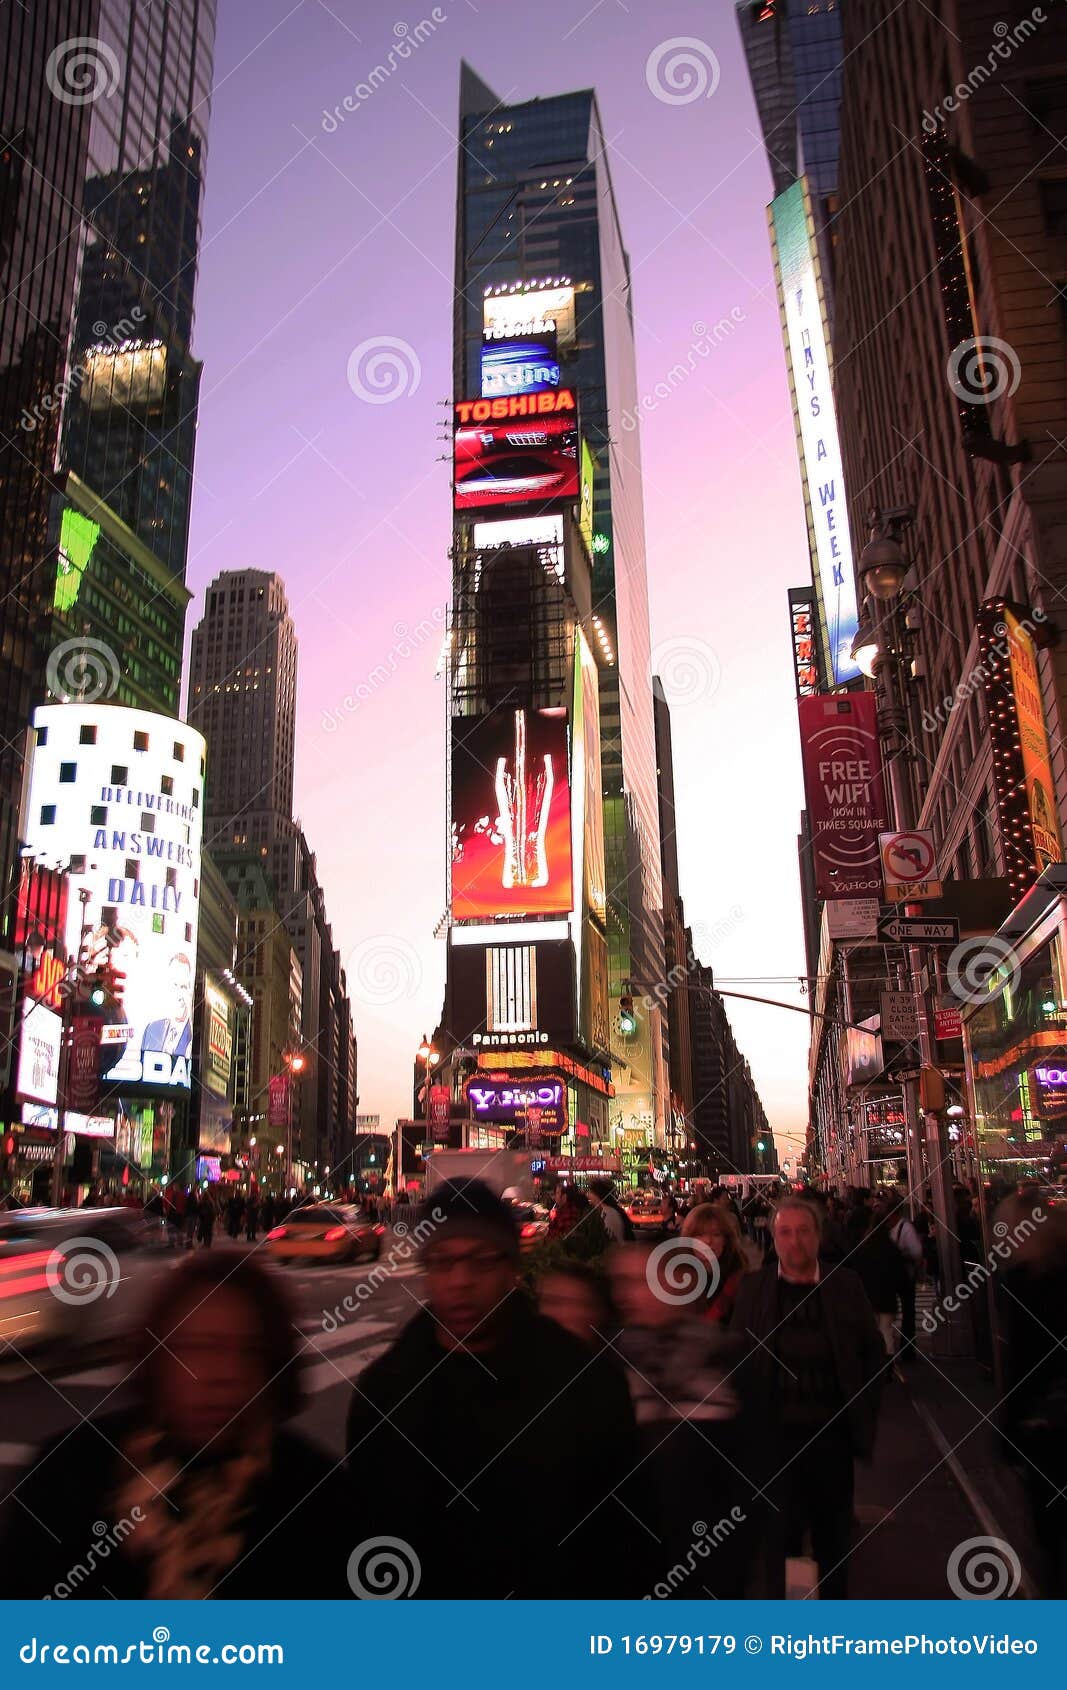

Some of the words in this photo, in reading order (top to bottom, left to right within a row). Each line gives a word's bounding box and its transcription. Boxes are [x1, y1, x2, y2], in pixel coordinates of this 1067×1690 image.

[456, 389, 575, 423] TOSHIBA
[819, 480, 845, 587] WEEK
[819, 760, 872, 782] FREE
[824, 783, 871, 804] WIFI
[101, 786, 194, 823] DELIVERING
[832, 807, 854, 817] NOW
[857, 807, 867, 816] IN
[817, 820, 846, 830] TIMES
[849, 819, 884, 829] SQUARE
[94, 829, 193, 869] ANSWERS
[107, 878, 182, 914] DAILY
[831, 879, 882, 893] YAHOO!
[896, 884, 929, 897] NEW
[889, 925, 912, 936] ONE
[923, 926, 949, 936] WAY
[472, 1030, 549, 1046] Panasonic
